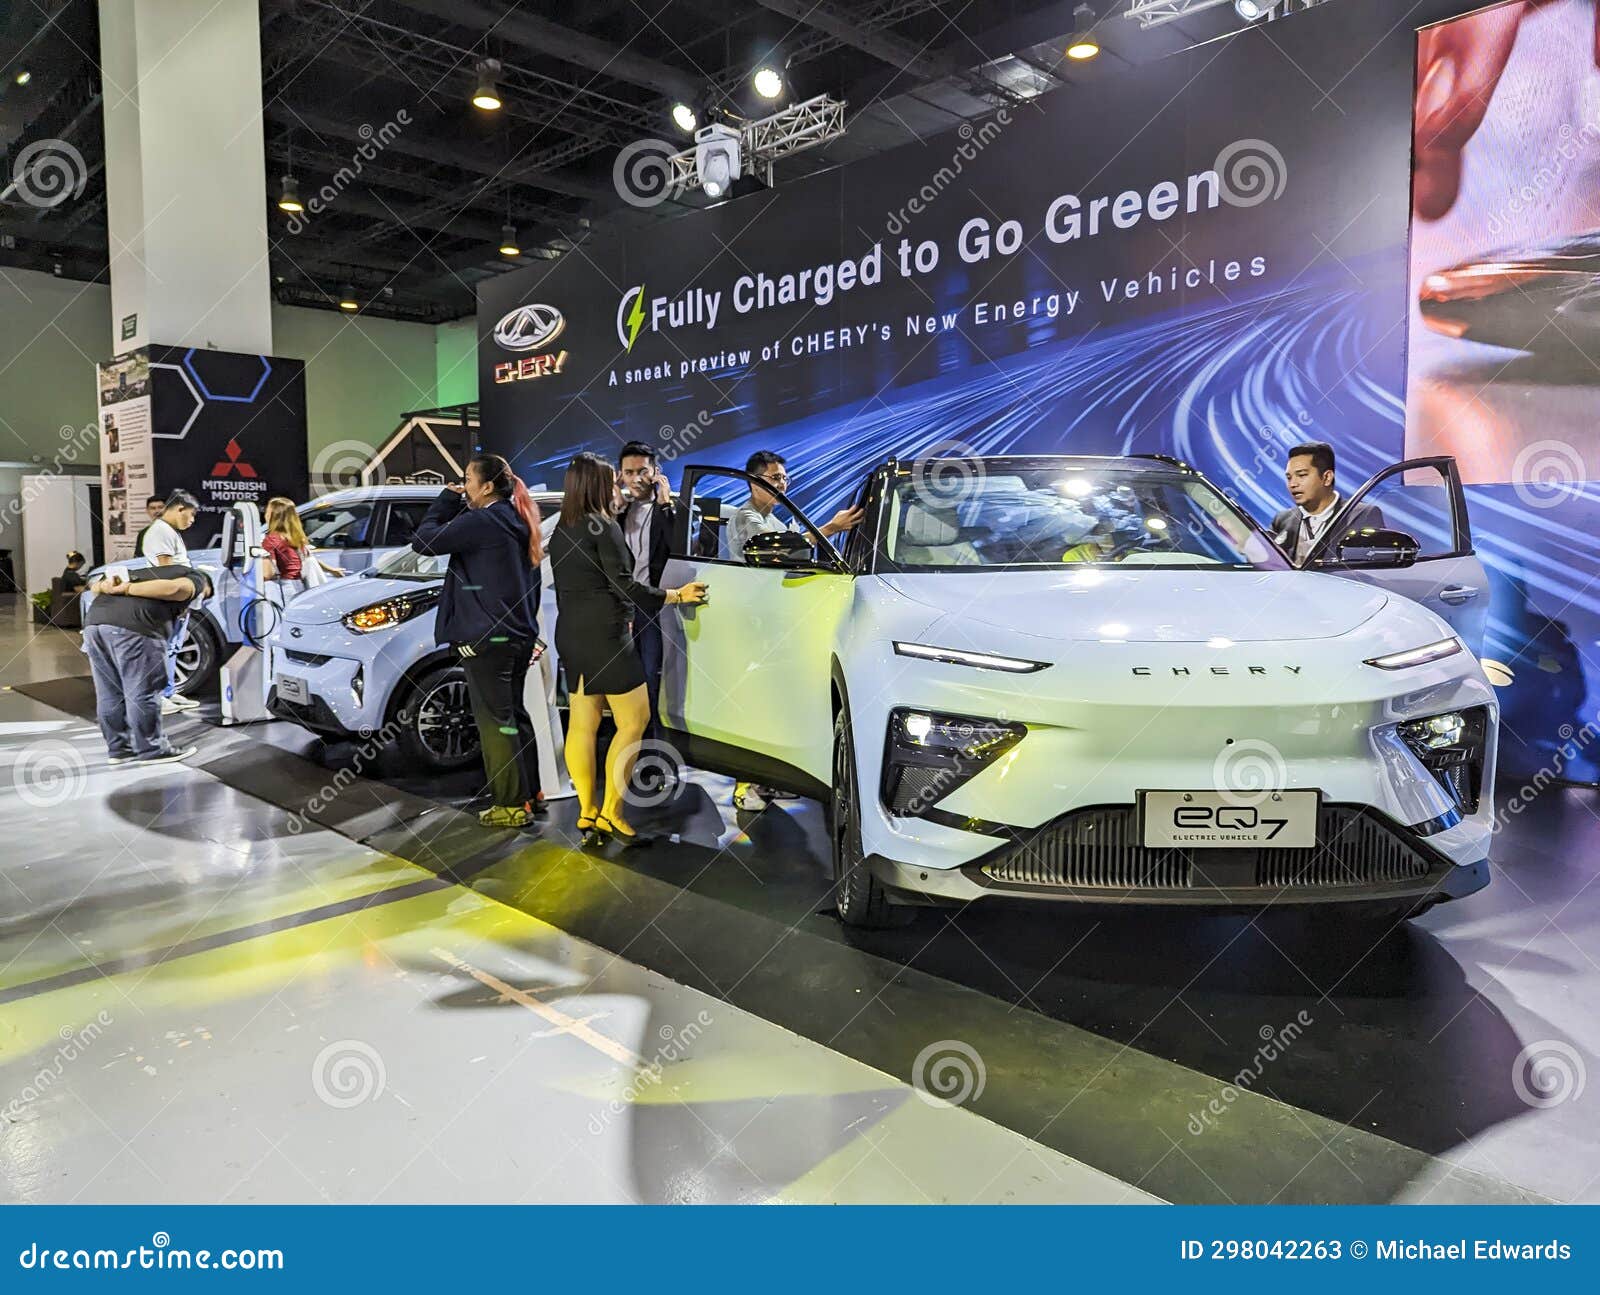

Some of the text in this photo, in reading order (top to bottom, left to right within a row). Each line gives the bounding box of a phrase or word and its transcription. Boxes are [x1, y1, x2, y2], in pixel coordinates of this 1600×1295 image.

[651, 169, 1221, 332] Fully Charged to Go Green
[608, 254, 1268, 387] A sneak preview of CHERY's New Energy Vehicles
[494, 350, 569, 384] CHERY
[202, 480, 267, 491] MITSUBISHI
[211, 491, 260, 501] MOTORS
[1131, 665, 1303, 676] CHERY
